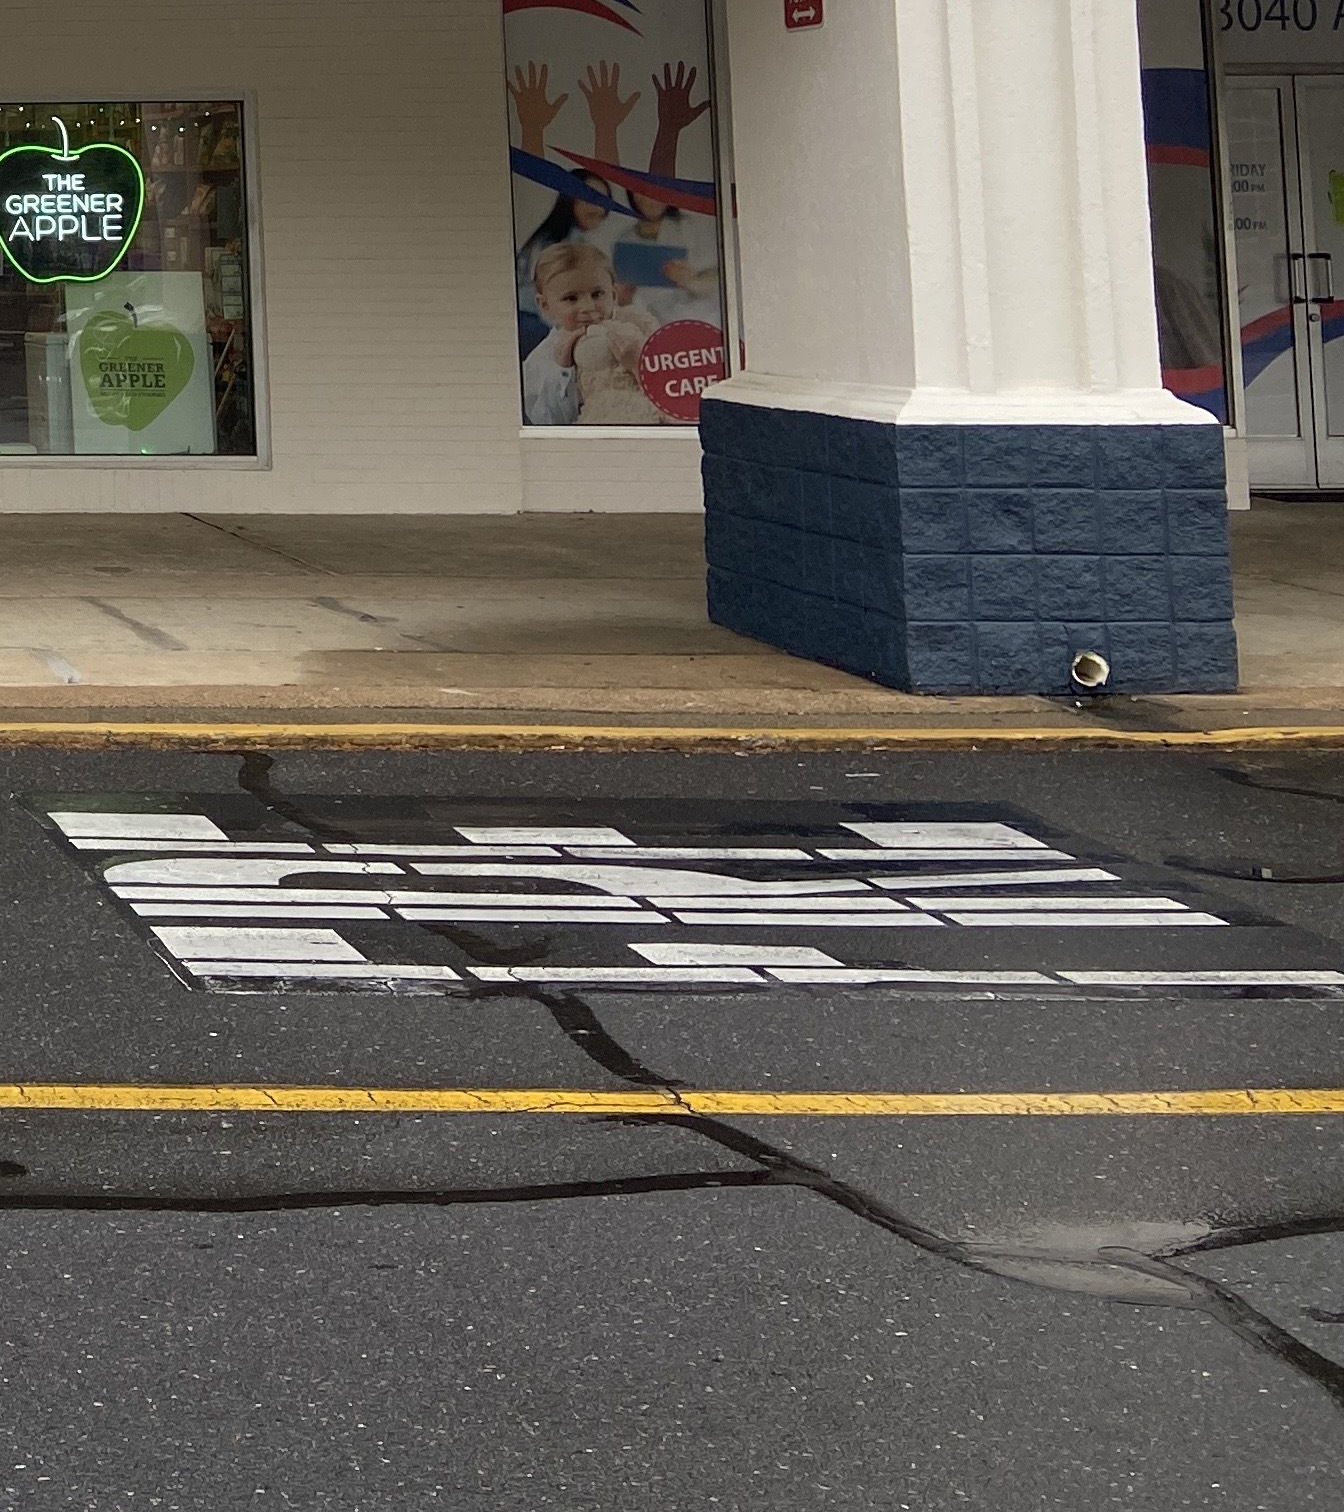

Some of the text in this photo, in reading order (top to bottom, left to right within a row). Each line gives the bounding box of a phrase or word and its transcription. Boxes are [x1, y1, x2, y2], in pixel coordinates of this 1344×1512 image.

[42, 174, 86, 191] THE
[5, 193, 123, 215] GREENER
[8, 214, 123, 241] APPLE
[99, 362, 165, 372] GREENER
[645, 347, 724, 372] URGENT
[99, 373, 166, 388] APPLE
